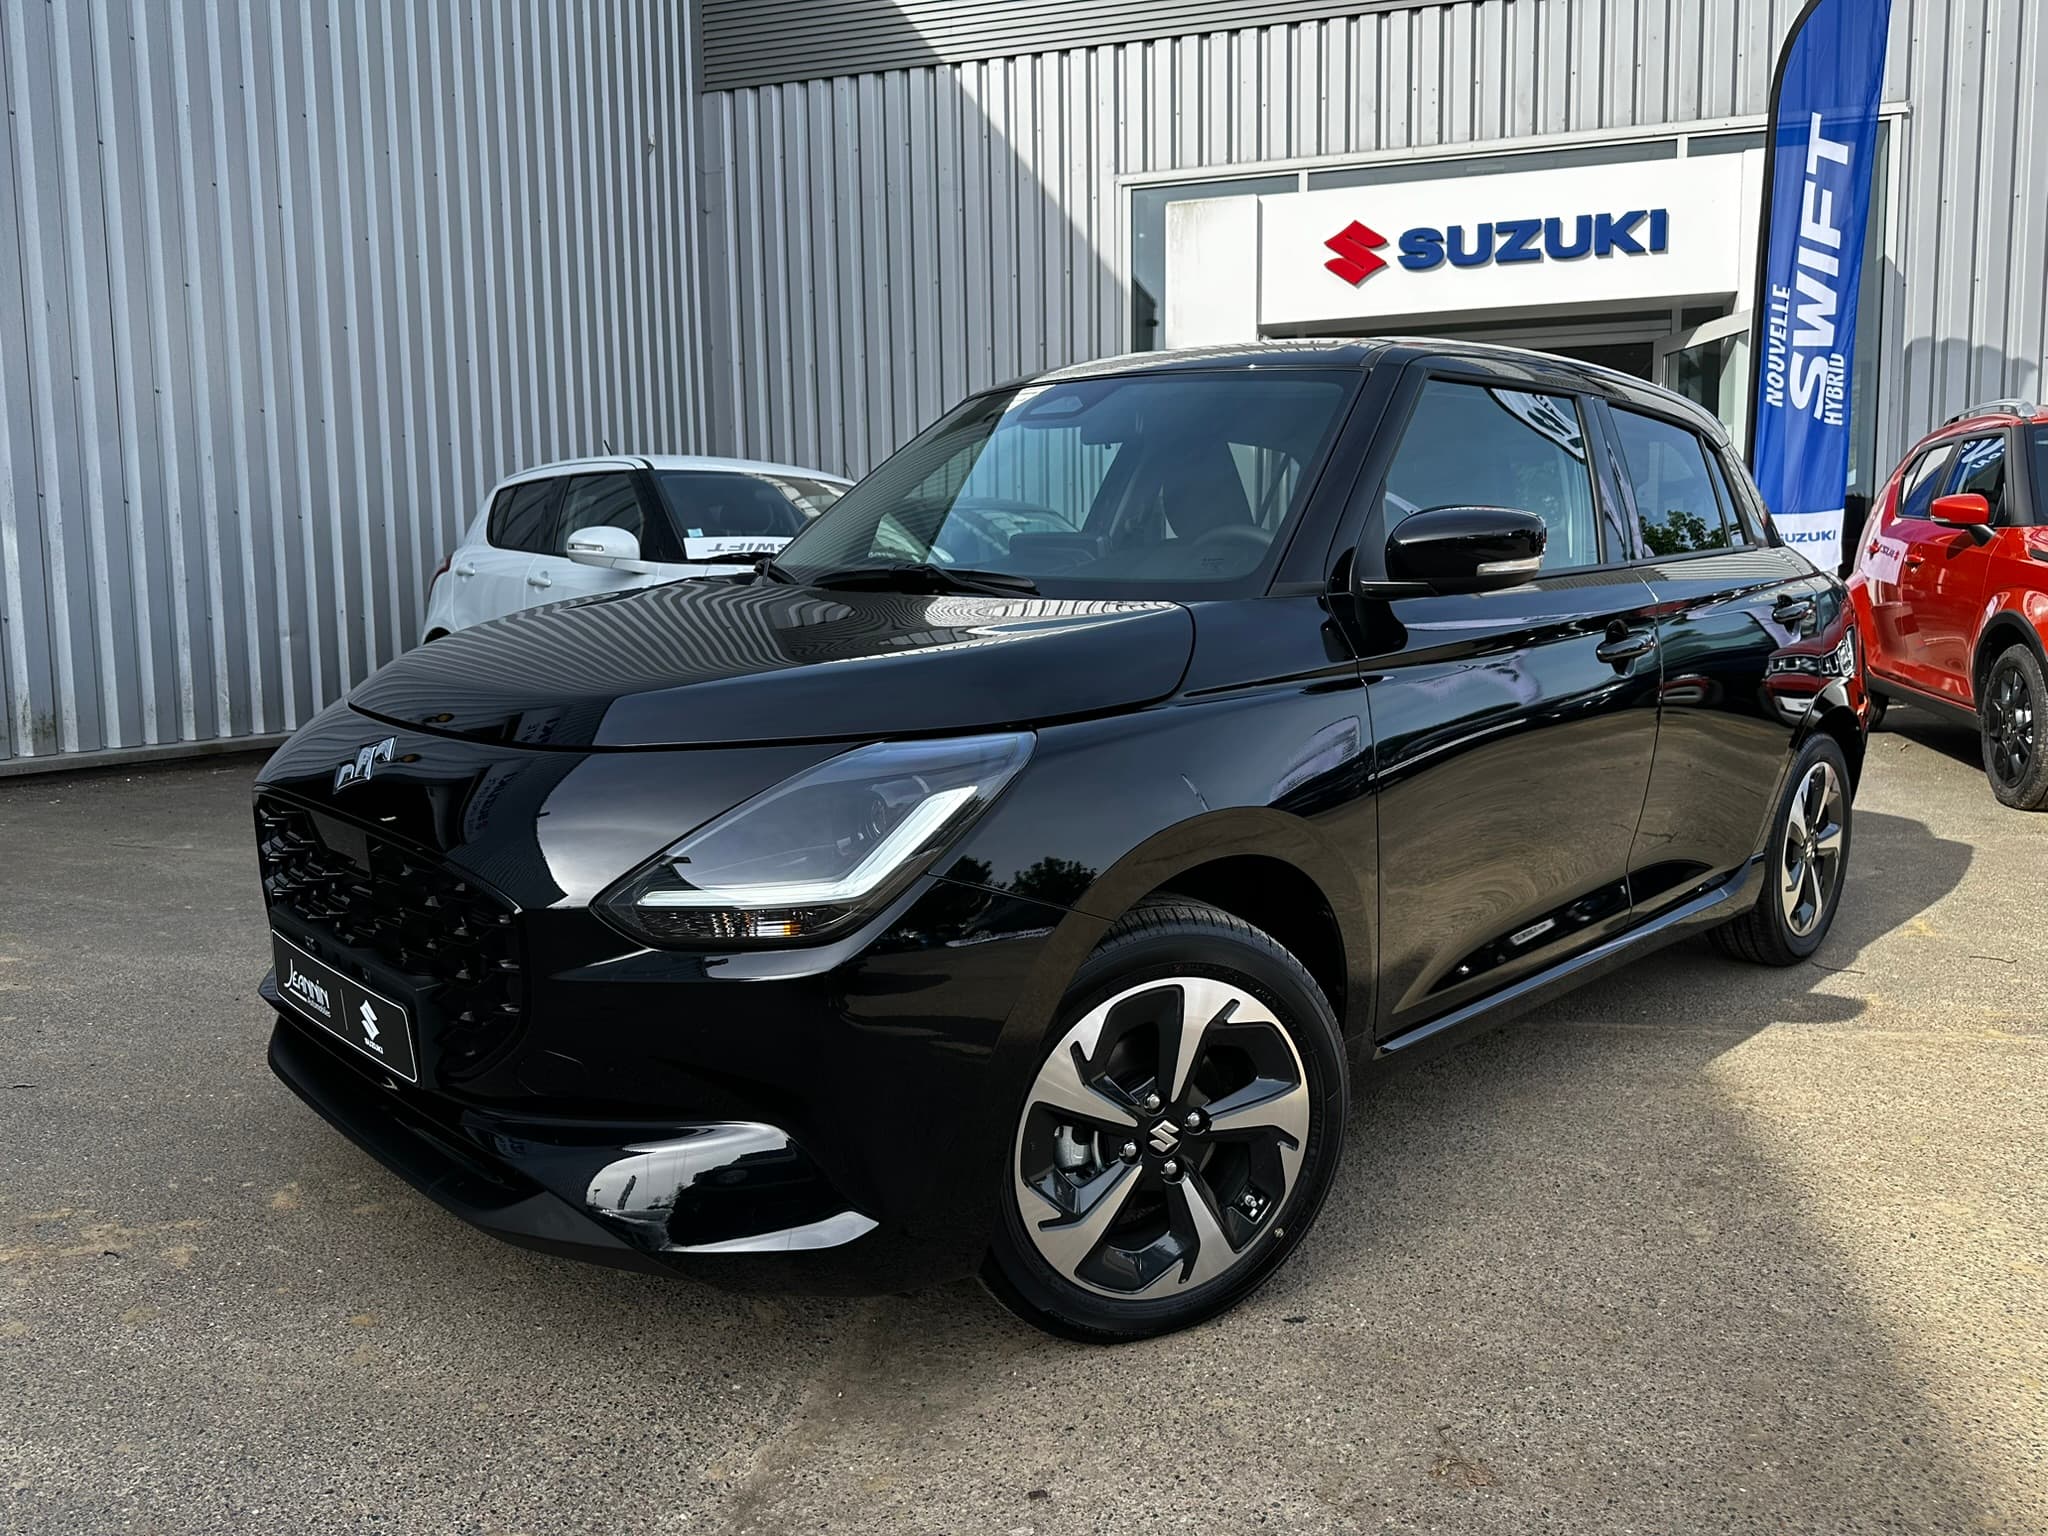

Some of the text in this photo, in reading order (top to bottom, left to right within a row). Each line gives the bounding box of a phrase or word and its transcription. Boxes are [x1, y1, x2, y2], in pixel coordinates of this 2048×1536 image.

[1397, 208, 1667, 271] SUZUKI
[1789, 111, 1849, 420] SWIFT
[1766, 283, 1791, 408] NOUVELLE
[1824, 351, 1845, 426] HYBRID
